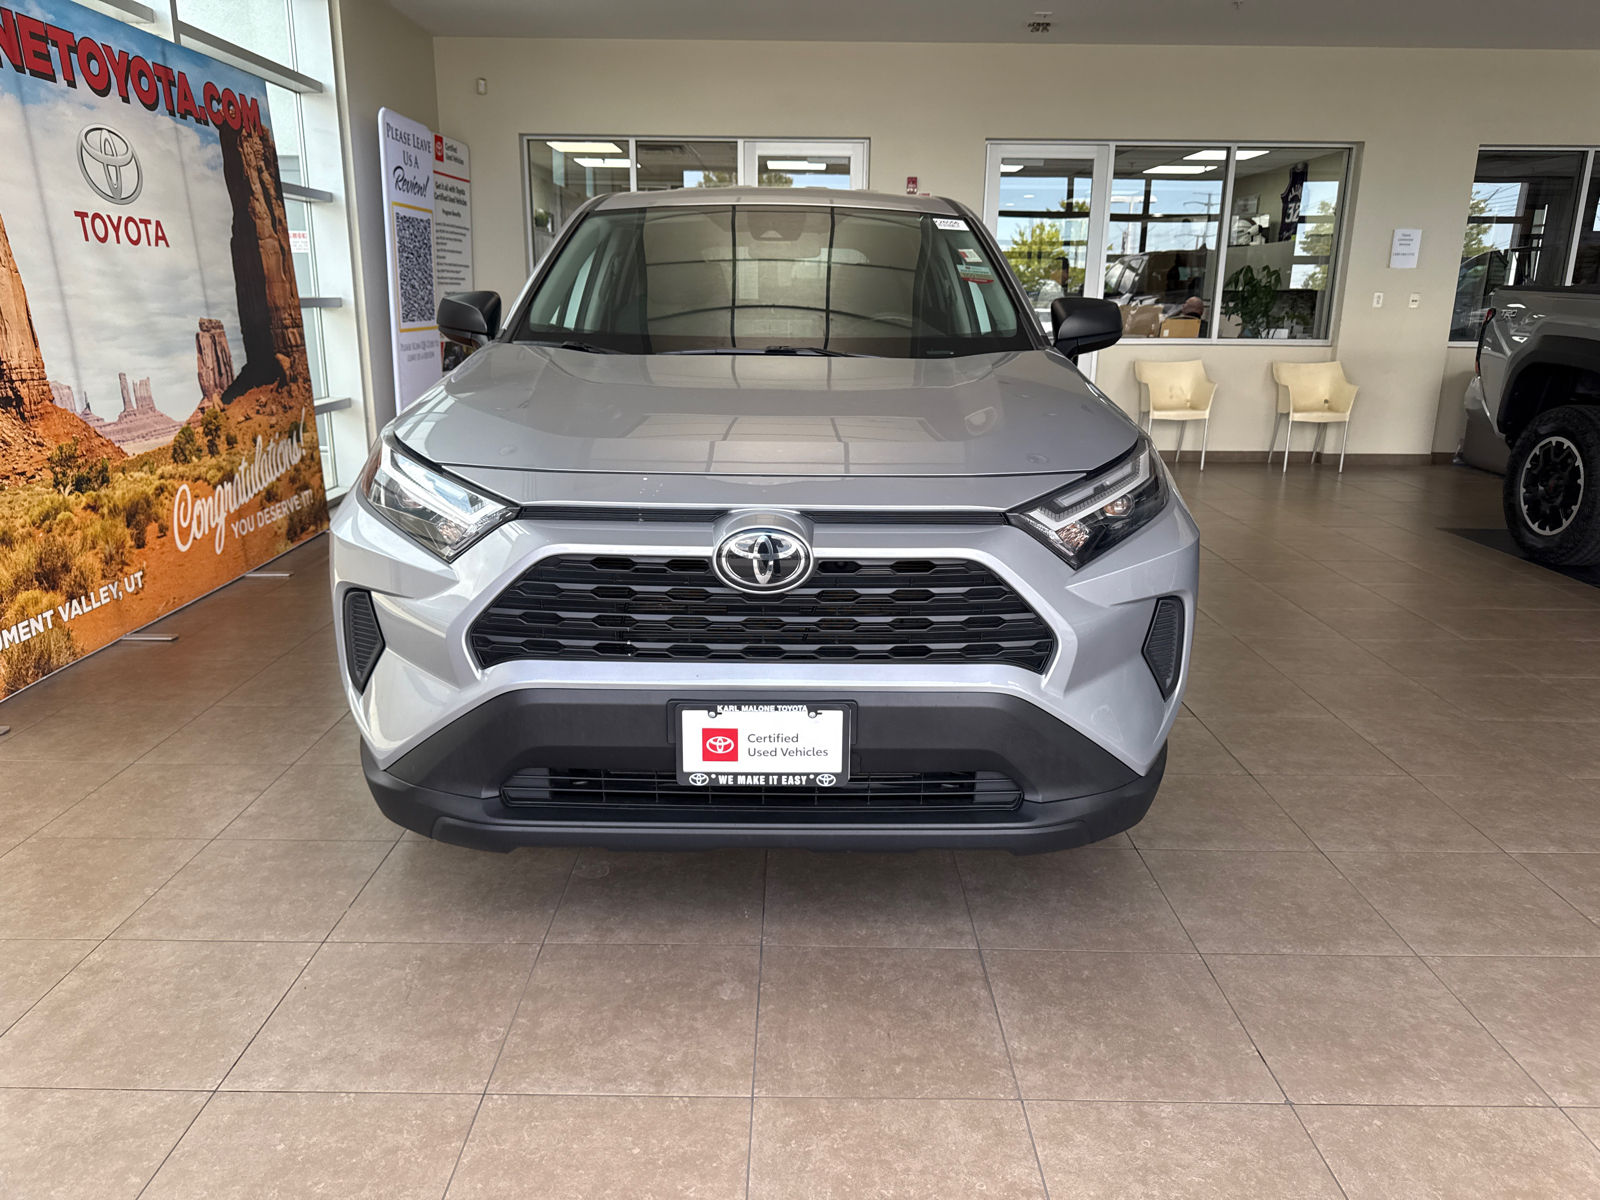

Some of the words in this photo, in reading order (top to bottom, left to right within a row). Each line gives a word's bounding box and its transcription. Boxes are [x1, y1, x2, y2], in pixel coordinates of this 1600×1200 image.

[386, 122, 411, 147] PLEASE
[412, 133, 432, 154] LEAVE
[414, 155, 420, 169] A
[393, 166, 430, 198] Review!
[73, 210, 170, 248] TOYOTA
[173, 407, 306, 555] Congratulations!
[231, 515, 255, 539] YOU
[256, 494, 301, 528] DESERVE
[301, 489, 314, 508] IT!
[0, 609, 54, 652] MENT
[57, 581, 123, 622] VALLEY,
[123, 570, 143, 593] UT
[747, 733, 799, 743] Certified
[747, 747, 777, 757] Used
[780, 747, 829, 757] Vehicles
[718, 775, 734, 785] WE
[737, 775, 766, 785] MAKE
[769, 775, 779, 785] IT
[781, 775, 807, 785] EASY
